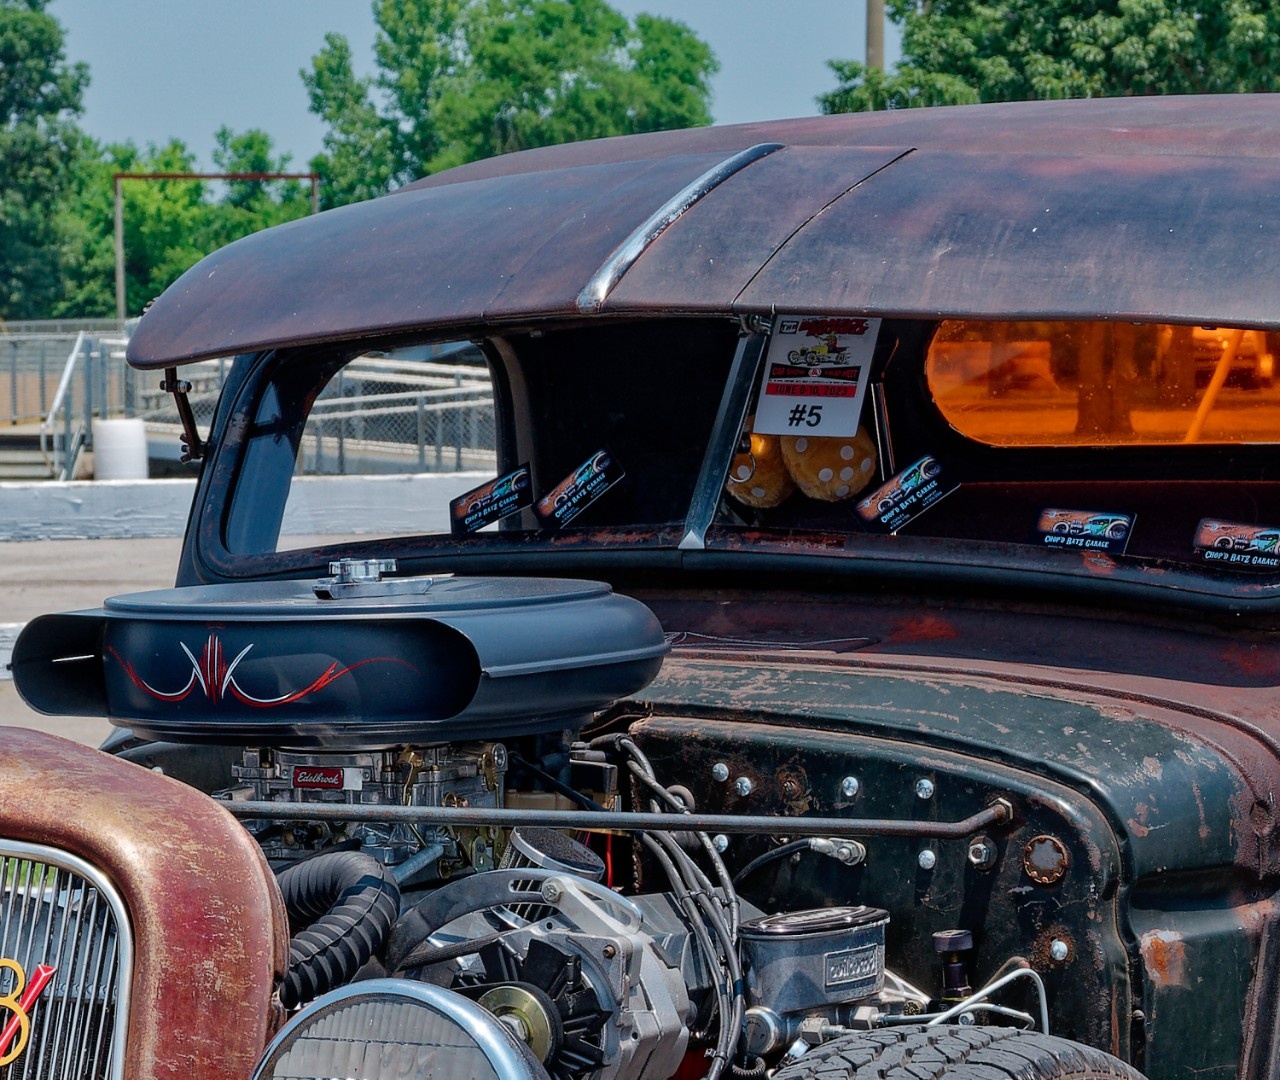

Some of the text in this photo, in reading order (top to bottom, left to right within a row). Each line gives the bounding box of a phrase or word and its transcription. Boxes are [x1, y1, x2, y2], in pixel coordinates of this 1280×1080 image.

[823, 386, 848, 396] 2023
[788, 404, 823, 427] #5
[297, 770, 340, 785] Edelbrock
